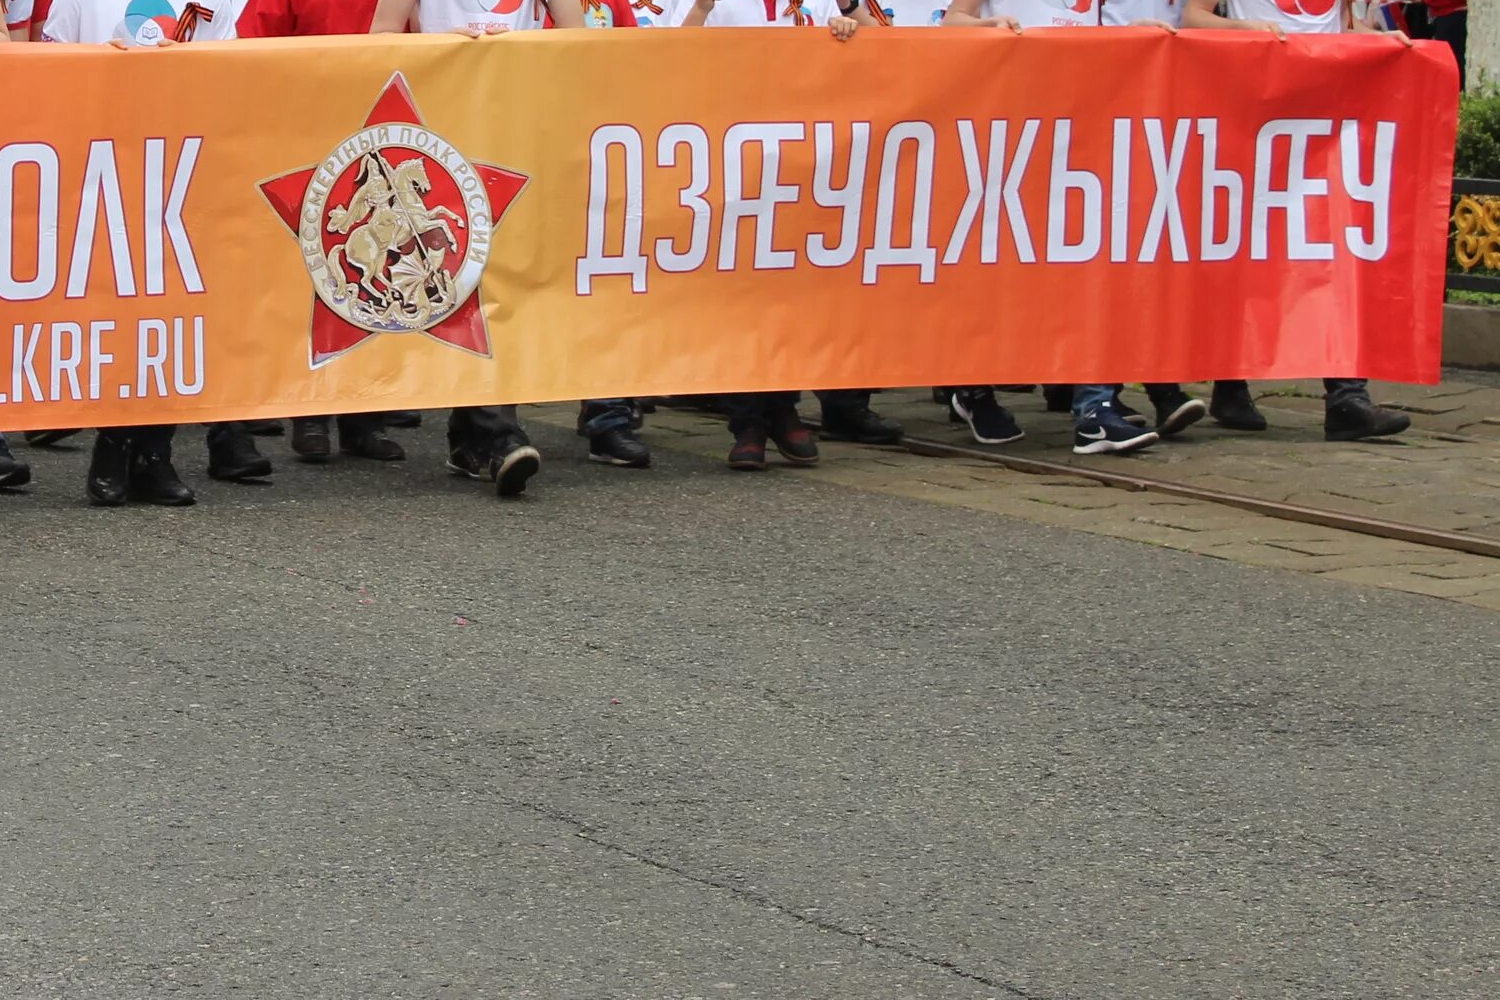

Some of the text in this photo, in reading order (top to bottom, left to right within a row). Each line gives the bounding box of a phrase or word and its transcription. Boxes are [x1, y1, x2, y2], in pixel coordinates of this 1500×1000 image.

[301, 125, 487, 272] БЕССМЕРТНЫЙ ПОЛК РОССИИ
